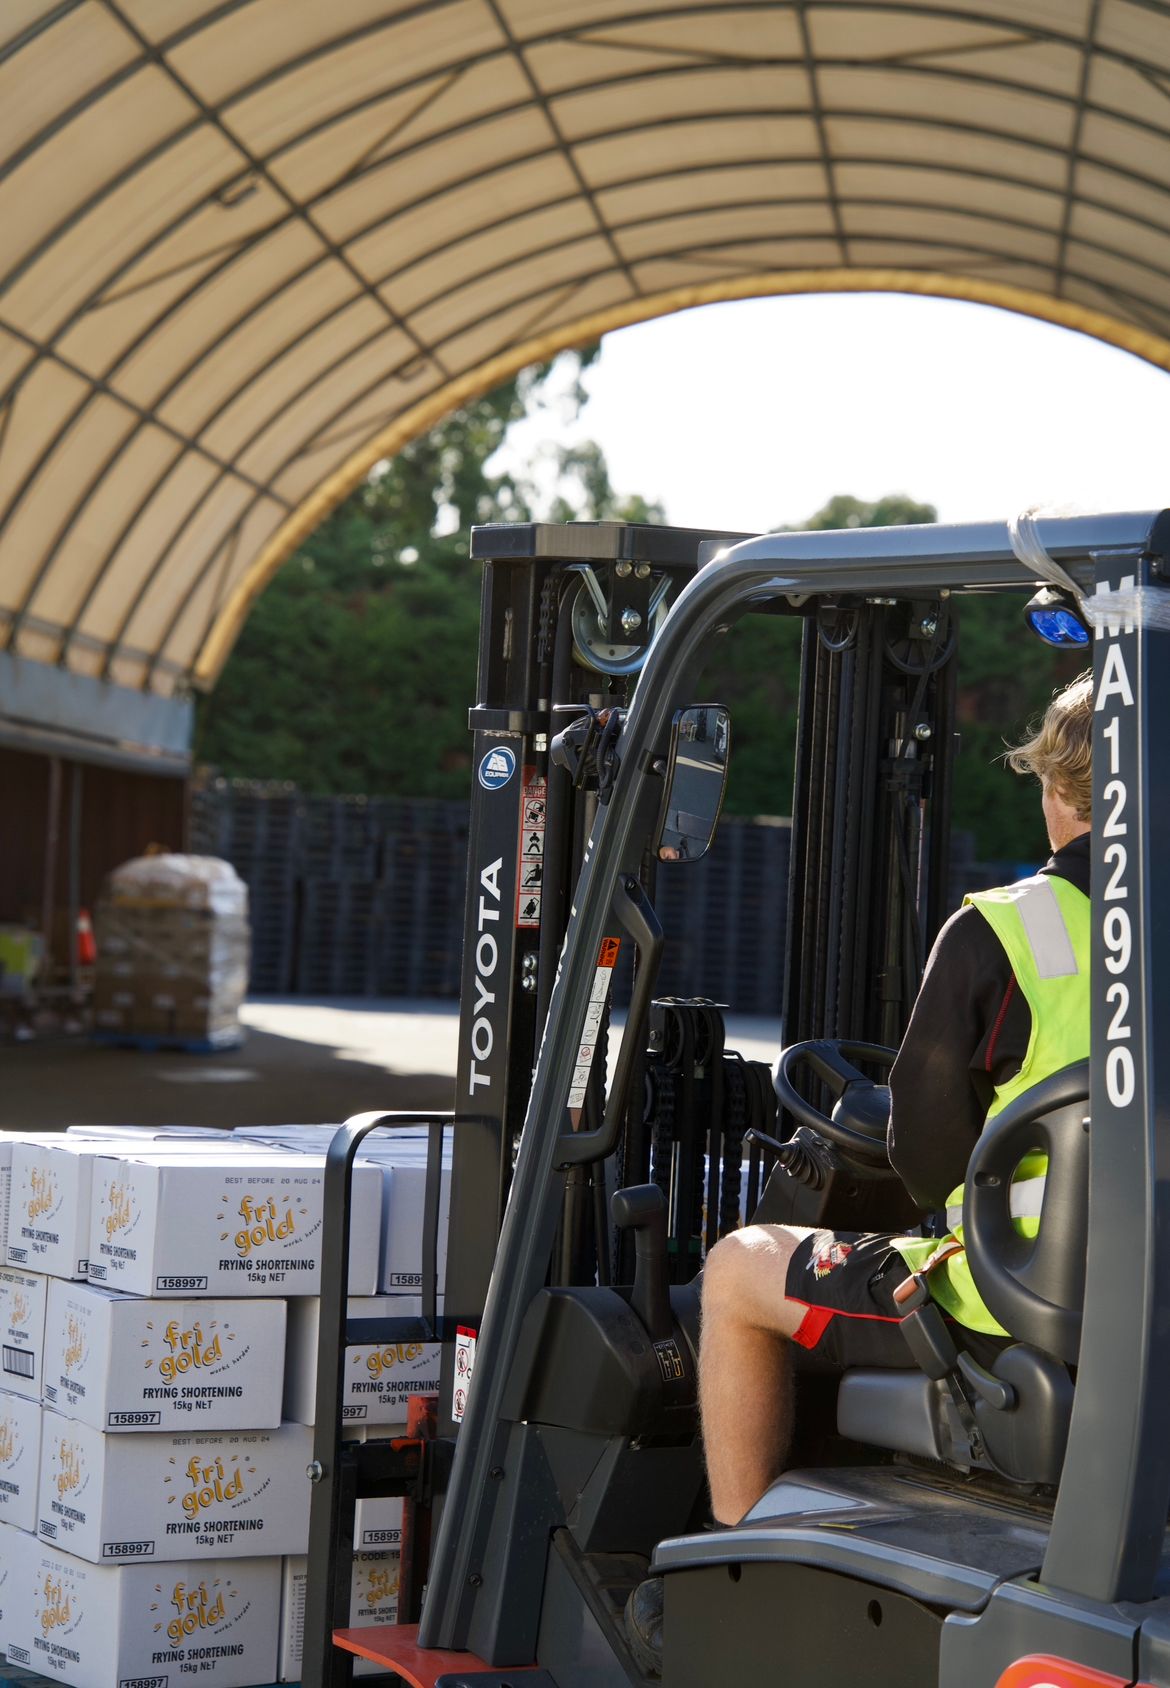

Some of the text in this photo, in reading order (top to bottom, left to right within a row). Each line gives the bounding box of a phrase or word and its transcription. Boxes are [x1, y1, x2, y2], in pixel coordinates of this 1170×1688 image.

[524, 786, 547, 795] DANGE
[469, 857, 503, 1096] TOYOTA
[239, 1195, 277, 1225] fri
[235, 1208, 294, 1257] gold
[219, 1259, 314, 1270] FRYING SHORTENING
[162, 1279, 203, 1287] 158997
[248, 1273, 285, 1283] 15kg NET
[395, 1276, 422, 1284] 1589
[163, 1321, 203, 1353] fri
[159, 1334, 222, 1385] gold
[352, 1380, 440, 1393] FRYING SHORTENING
[143, 1387, 242, 1399] FRYING SHORTENING
[173, 1400, 213, 1411] 15kg NET
[378, 1395, 396, 1405] 15kg
[343, 1408, 363, 1416] 997
[114, 1414, 156, 1423] 158997
[186, 1456, 224, 1487] fri
[182, 1468, 244, 1520] gold
[166, 1519, 263, 1534] FRYING SHORTENING
[195, 1534, 234, 1545] 15kg NET
[368, 1533, 401, 1541] 15899
[108, 1544, 149, 1554] 158997
[171, 1582, 208, 1615] fri
[42, 1595, 69, 1638] gold
[358, 1607, 397, 1616] FRYING SHORTE
[167, 1592, 225, 1648] gold
[34, 1637, 80, 1663] FRYING SHORTENING
[152, 1644, 244, 1663] FRYING SHORTENING
[180, 1661, 216, 1673] 15kg NET
[124, 1679, 163, 1688] 158997
